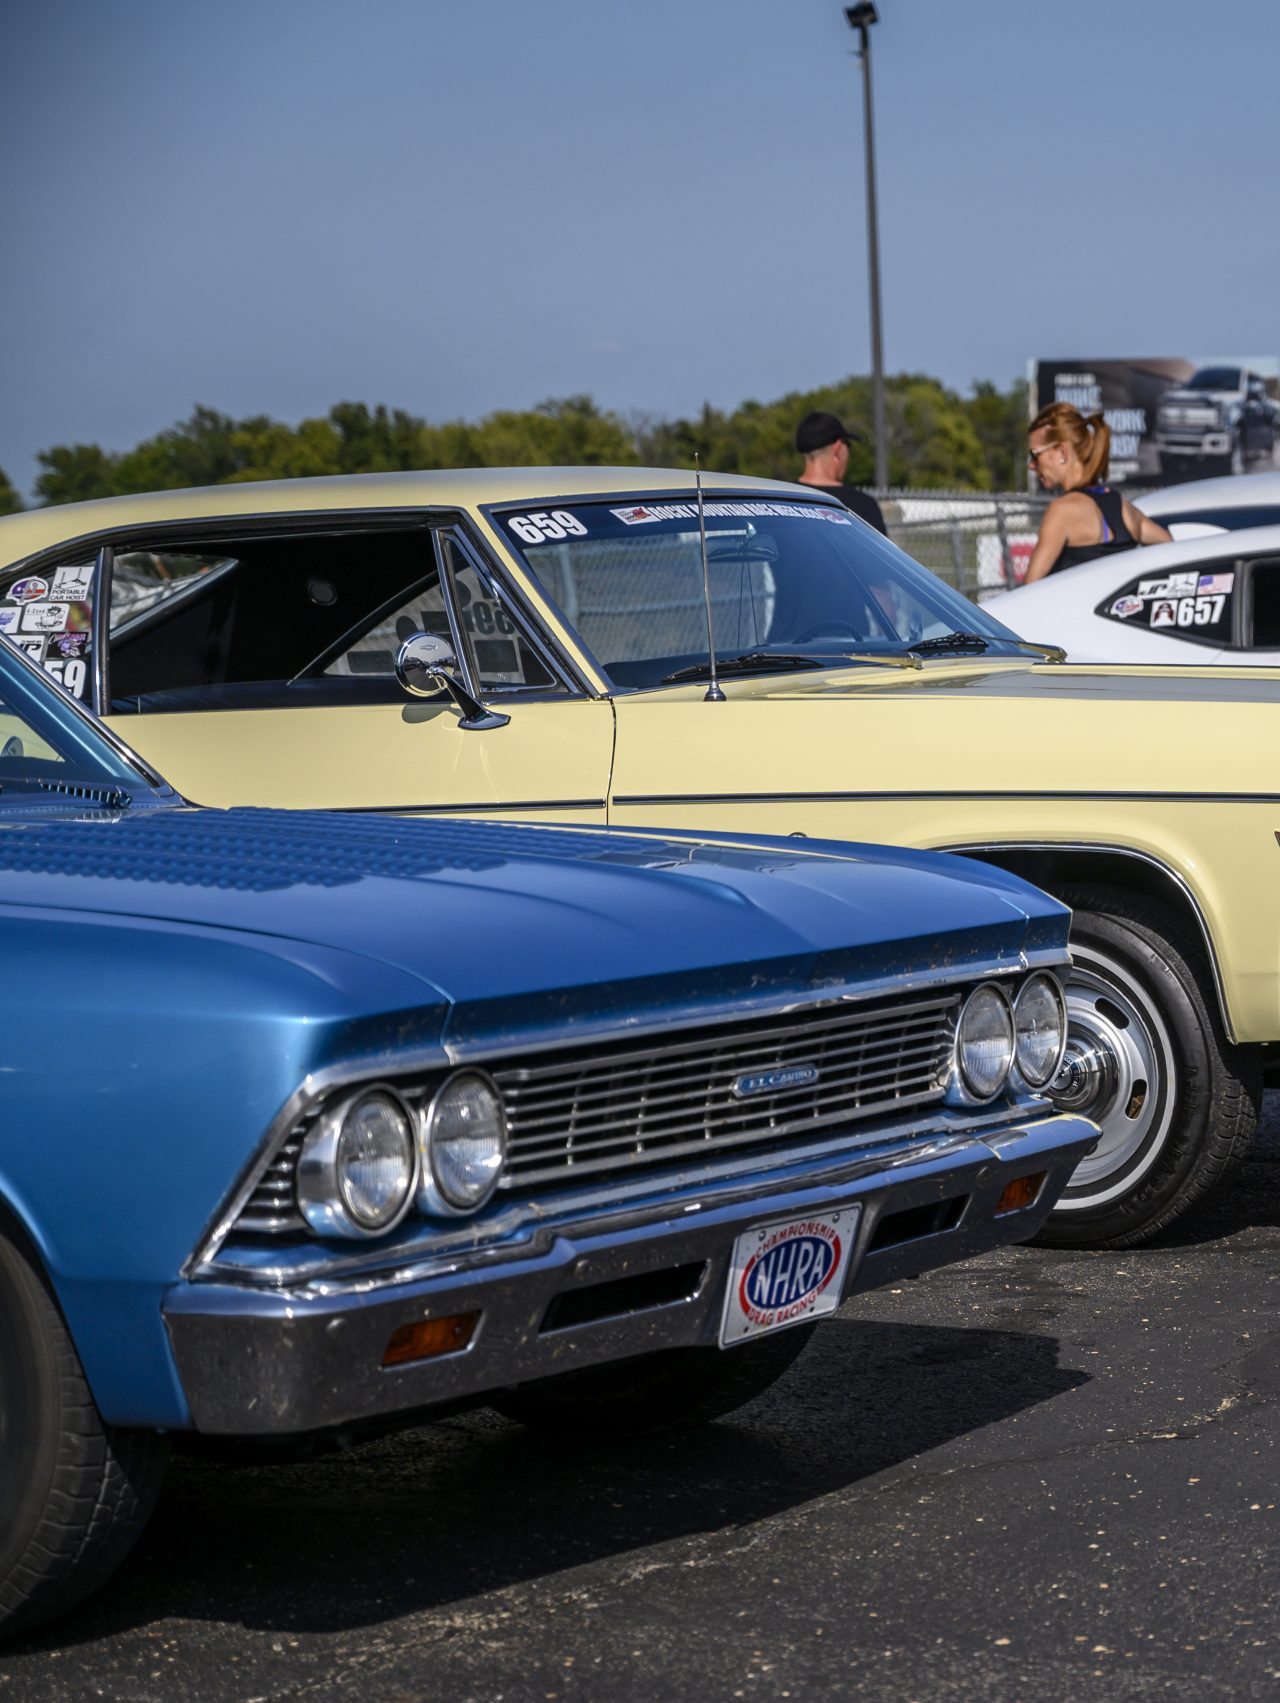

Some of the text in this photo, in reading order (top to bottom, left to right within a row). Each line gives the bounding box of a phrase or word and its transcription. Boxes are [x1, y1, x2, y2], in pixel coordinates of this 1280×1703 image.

[507, 511, 589, 544] 659
[647, 504, 697, 520] ROCKY
[1177, 594, 1226, 627] 657
[44, 660, 87, 699] 59
[755, 1221, 836, 1258] CHAMPIONSHIP
[752, 1240, 828, 1306] NHRA
[748, 1293, 819, 1327] DRAG RACING
